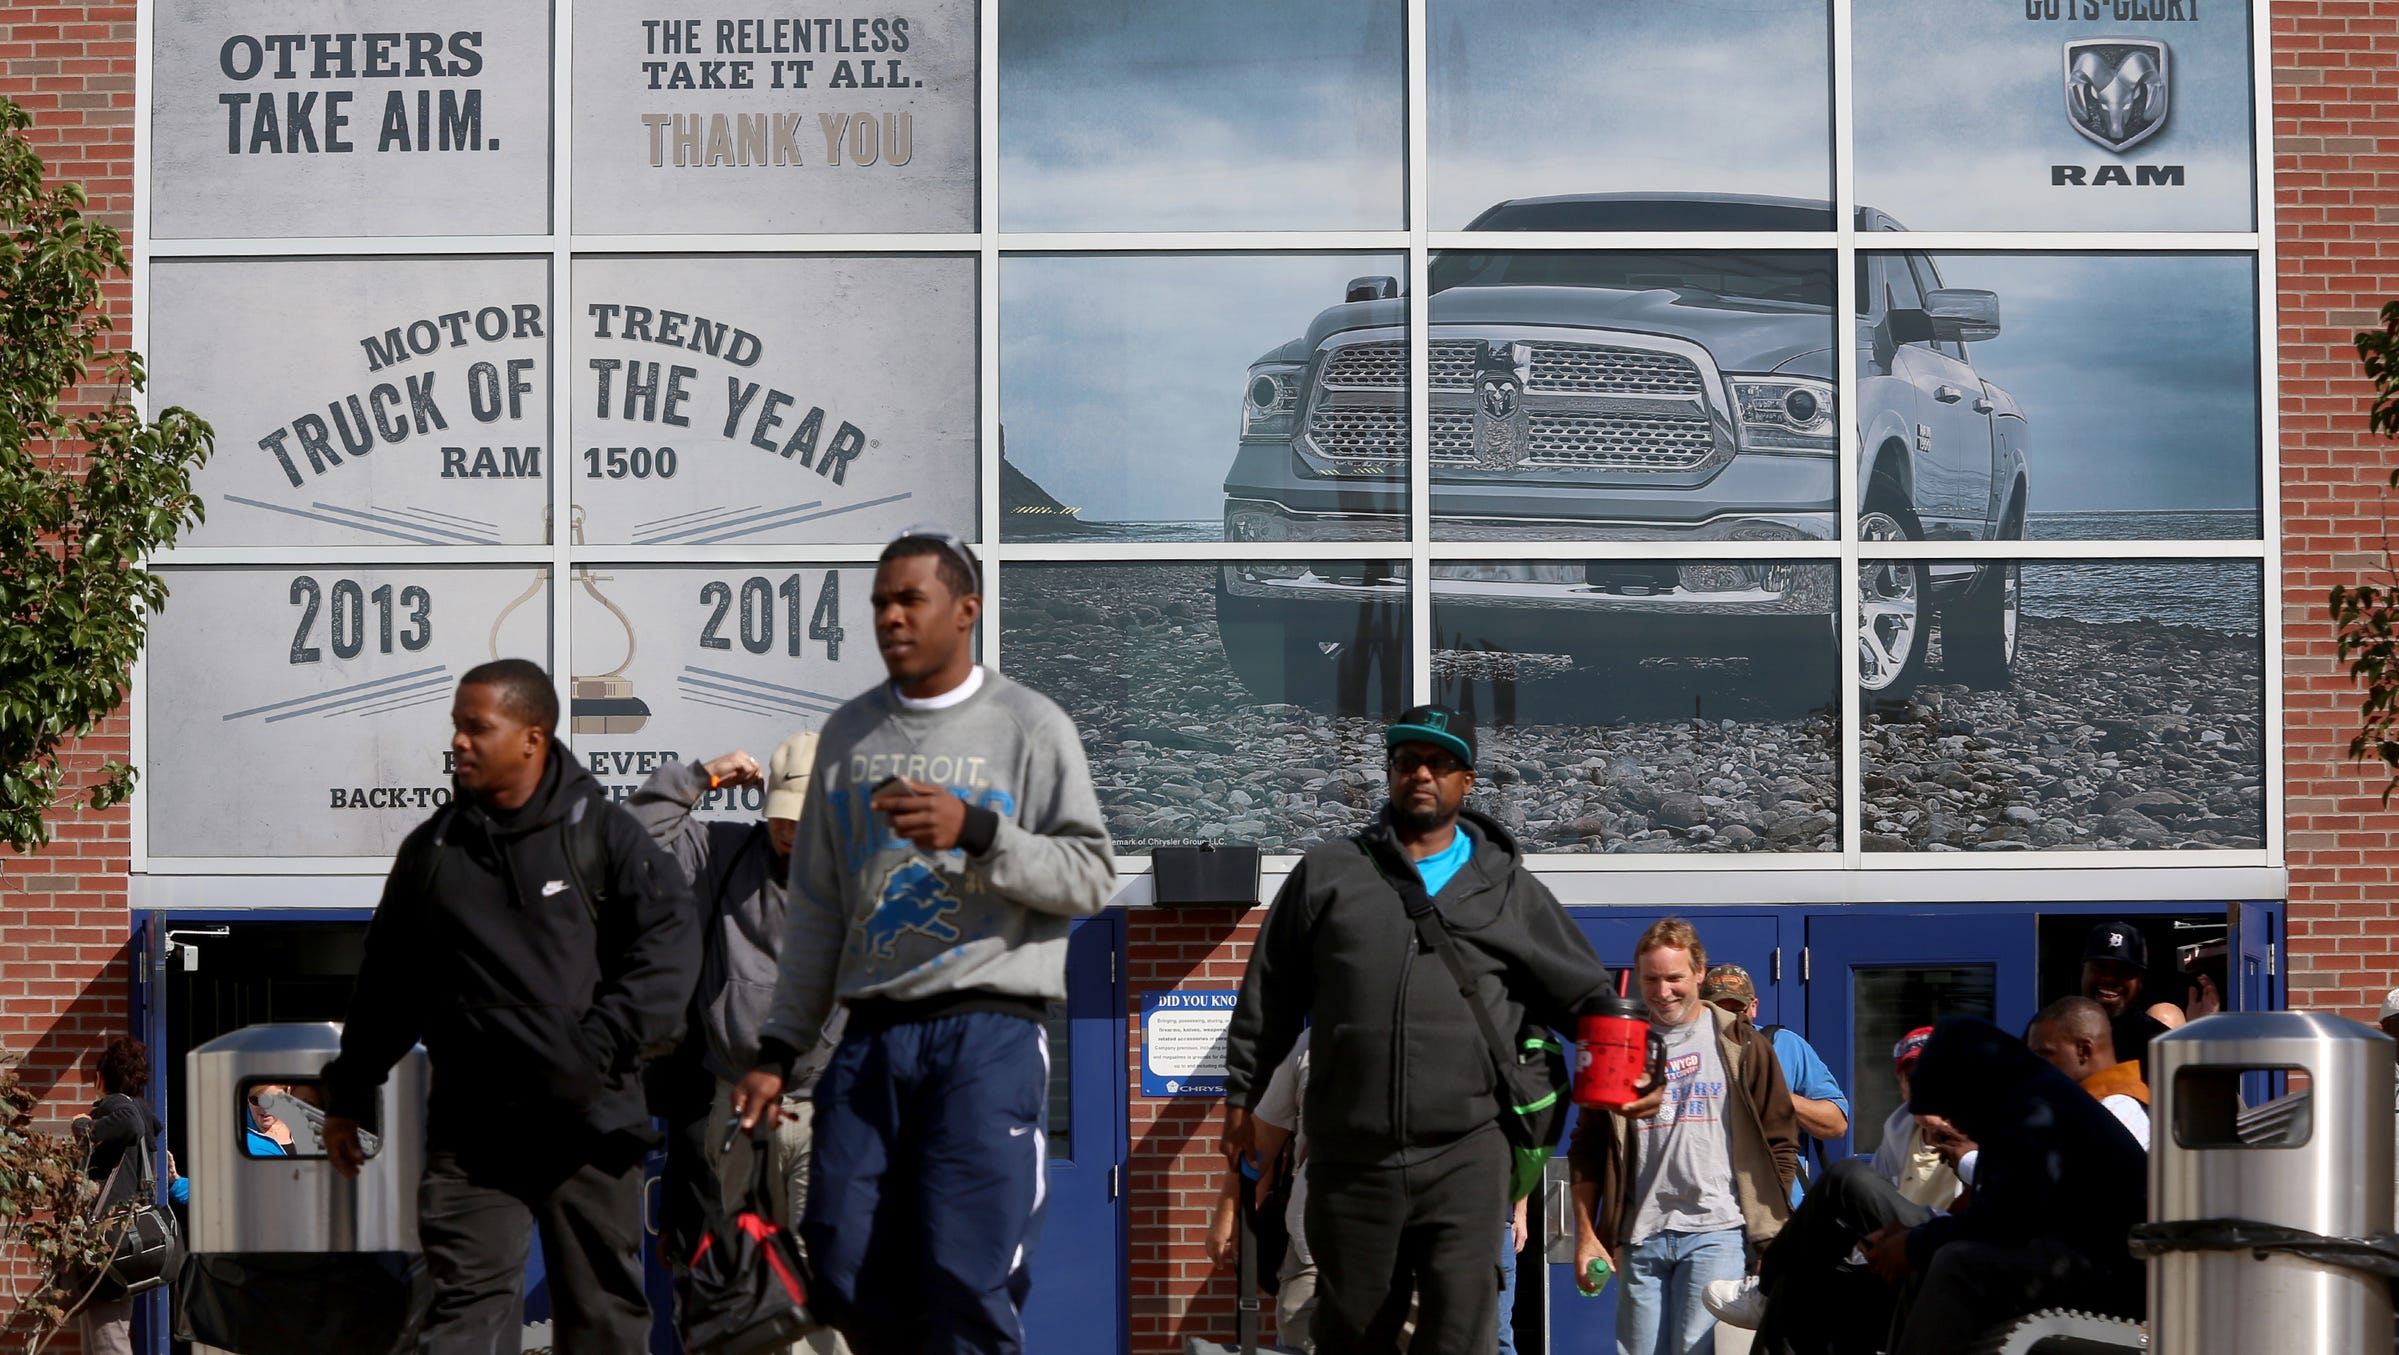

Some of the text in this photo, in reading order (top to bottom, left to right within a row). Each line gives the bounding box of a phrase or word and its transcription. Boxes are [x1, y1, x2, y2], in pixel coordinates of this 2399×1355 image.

[642, 18, 910, 54] THE RELENTLESS
[220, 31, 483, 80] OTHERS
[642, 60, 924, 90] TAKE IT ALL.
[219, 89, 500, 154] TAKE AIM.
[641, 112, 914, 168] THANK YOU
[2051, 165, 2185, 186] RAM
[360, 304, 763, 373] MOTOR TREND
[259, 359, 871, 489] TRUCK OF THE YEAR
[441, 446, 677, 480] RAM 1500
[289, 569, 844, 665] 2013 2014
[851, 753, 987, 786] DETROIT
[330, 787, 451, 809] BACK-TO
[1111, 837, 1136, 846] emark
[1147, 837, 1181, 848] Chrysler
[1158, 995, 1238, 1007] DID YOU KNO
[1669, 1055, 1699, 1071] WYCD
[1179, 1085, 1224, 1093] CHRYS
